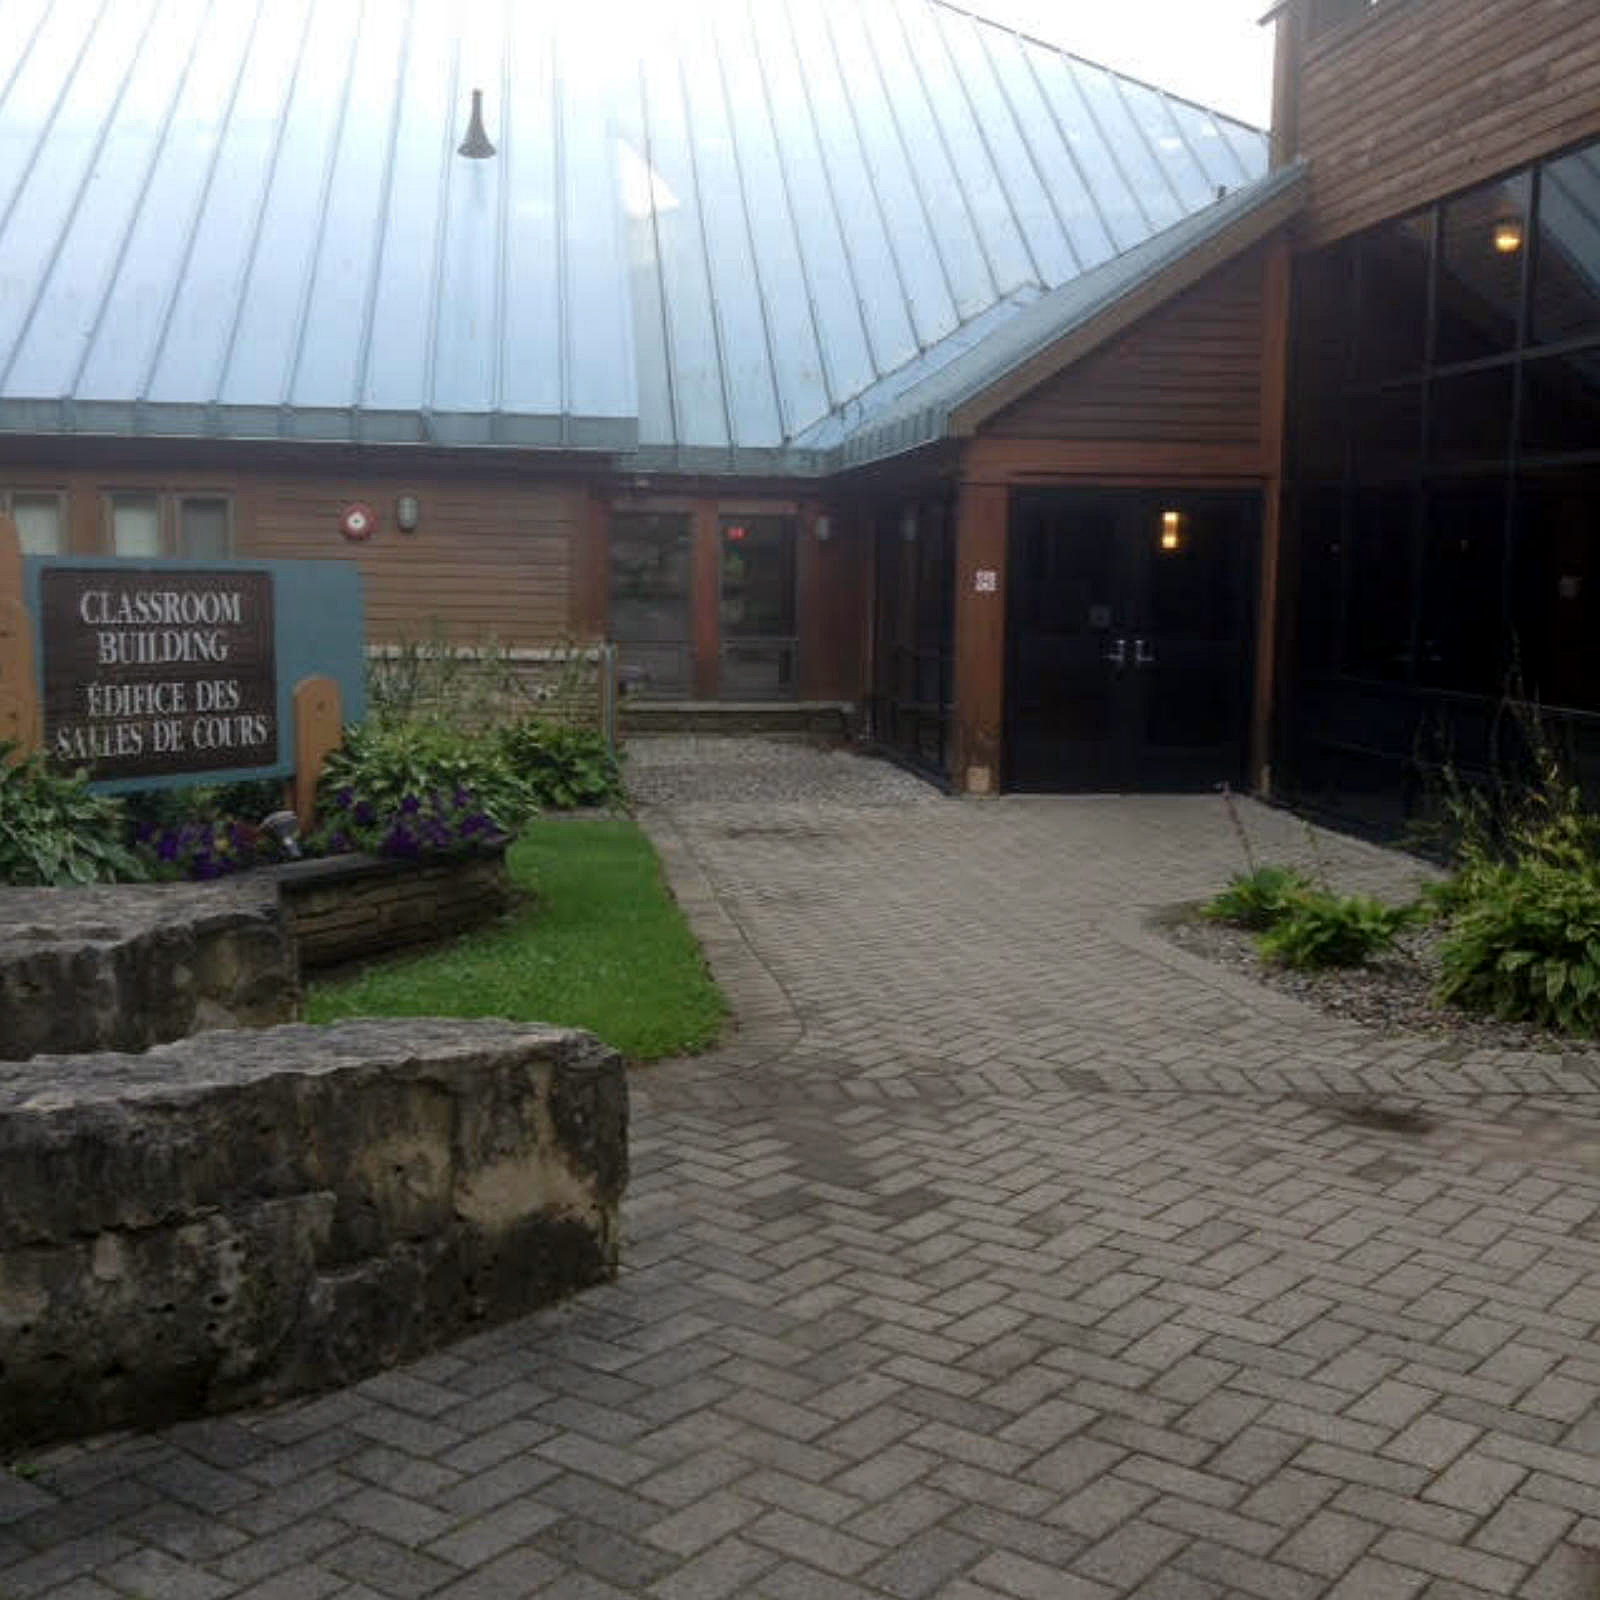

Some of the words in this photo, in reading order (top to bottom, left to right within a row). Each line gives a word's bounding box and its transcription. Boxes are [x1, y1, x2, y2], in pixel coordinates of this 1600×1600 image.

[80, 590, 242, 624] CLASSROOM
[97, 630, 229, 664] BUILDING
[196, 680, 240, 712] DES
[153, 719, 184, 752] DE
[193, 714, 269, 749] COURS
